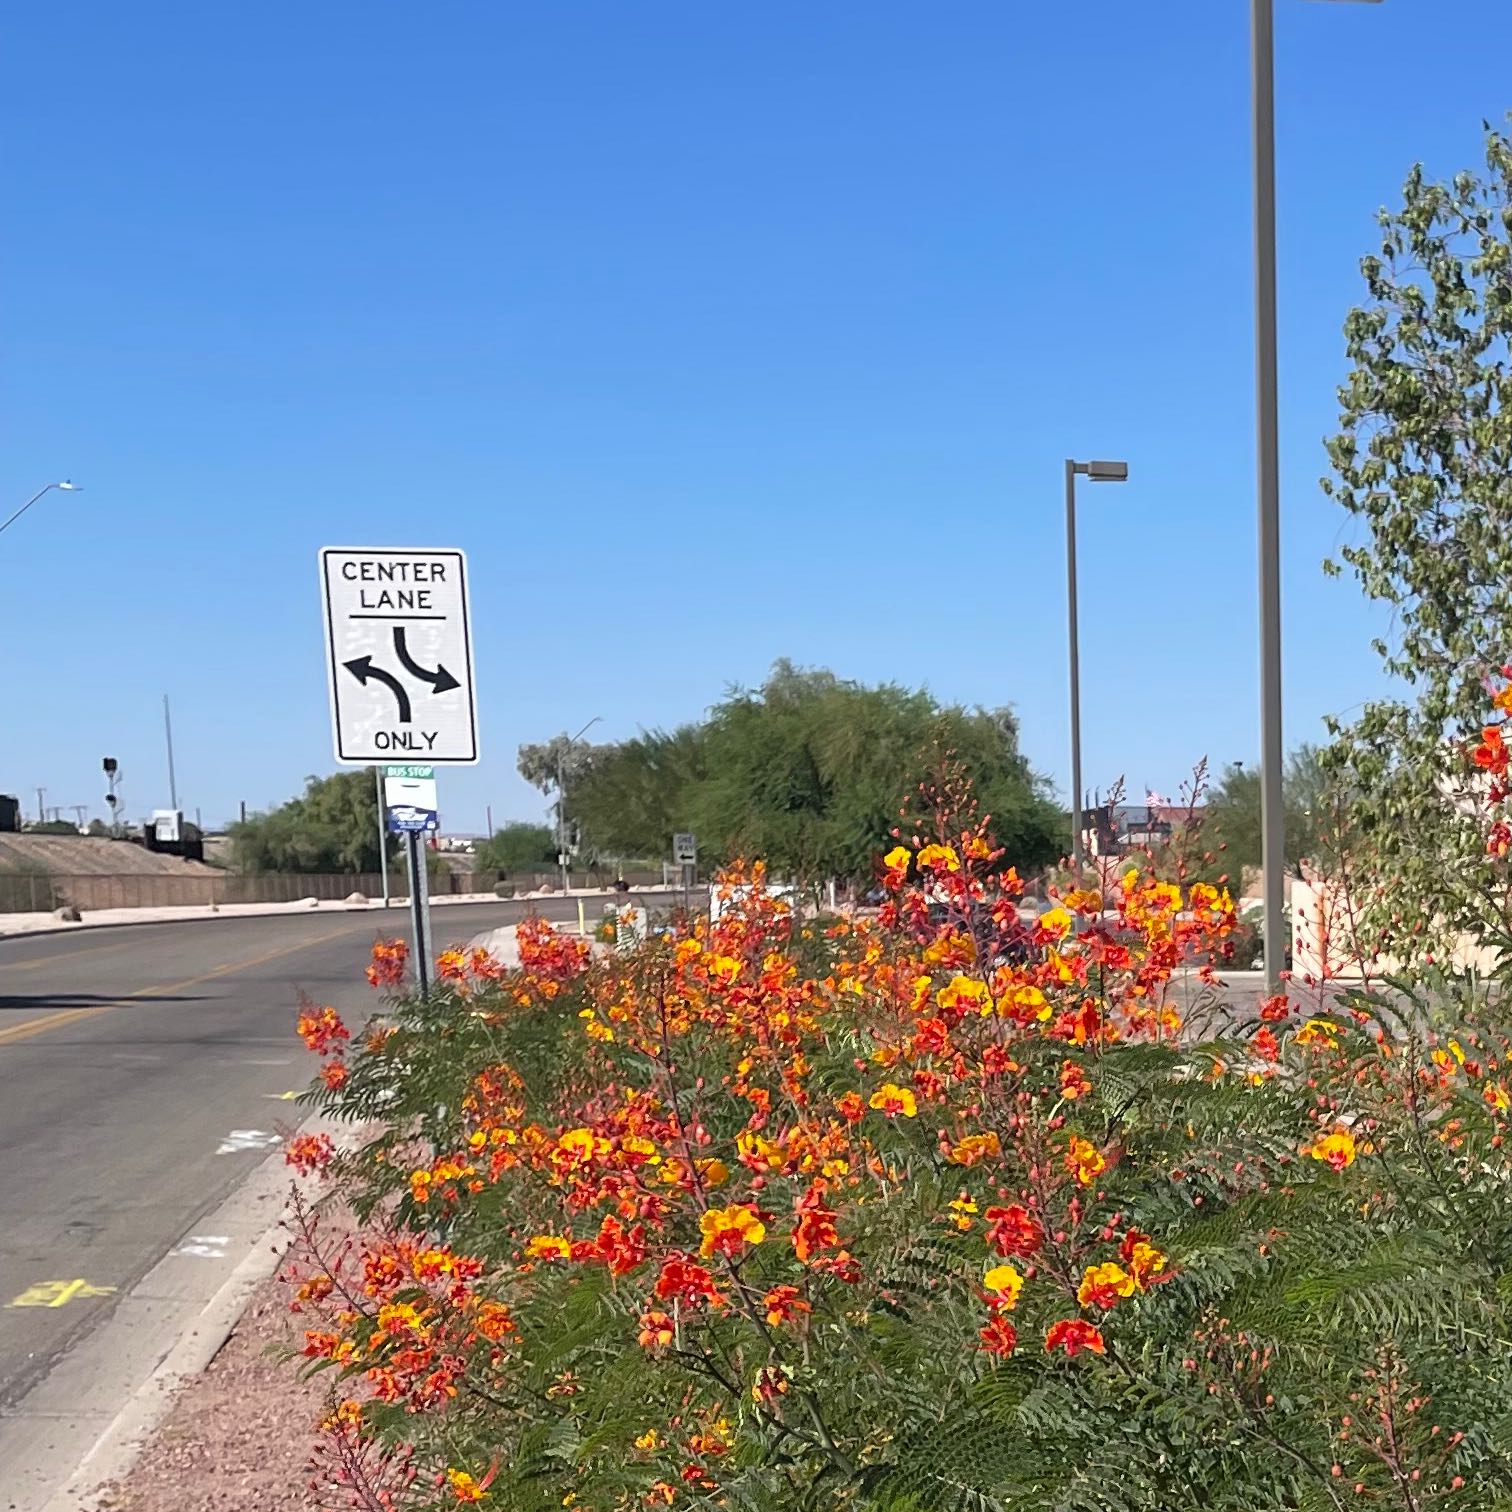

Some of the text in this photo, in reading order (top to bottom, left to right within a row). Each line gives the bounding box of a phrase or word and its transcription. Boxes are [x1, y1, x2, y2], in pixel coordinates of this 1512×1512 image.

[342, 562, 447, 582] CENTER
[360, 589, 433, 610] LANE
[374, 731, 439, 751] ONLY
[387, 766, 407, 777] BUS
